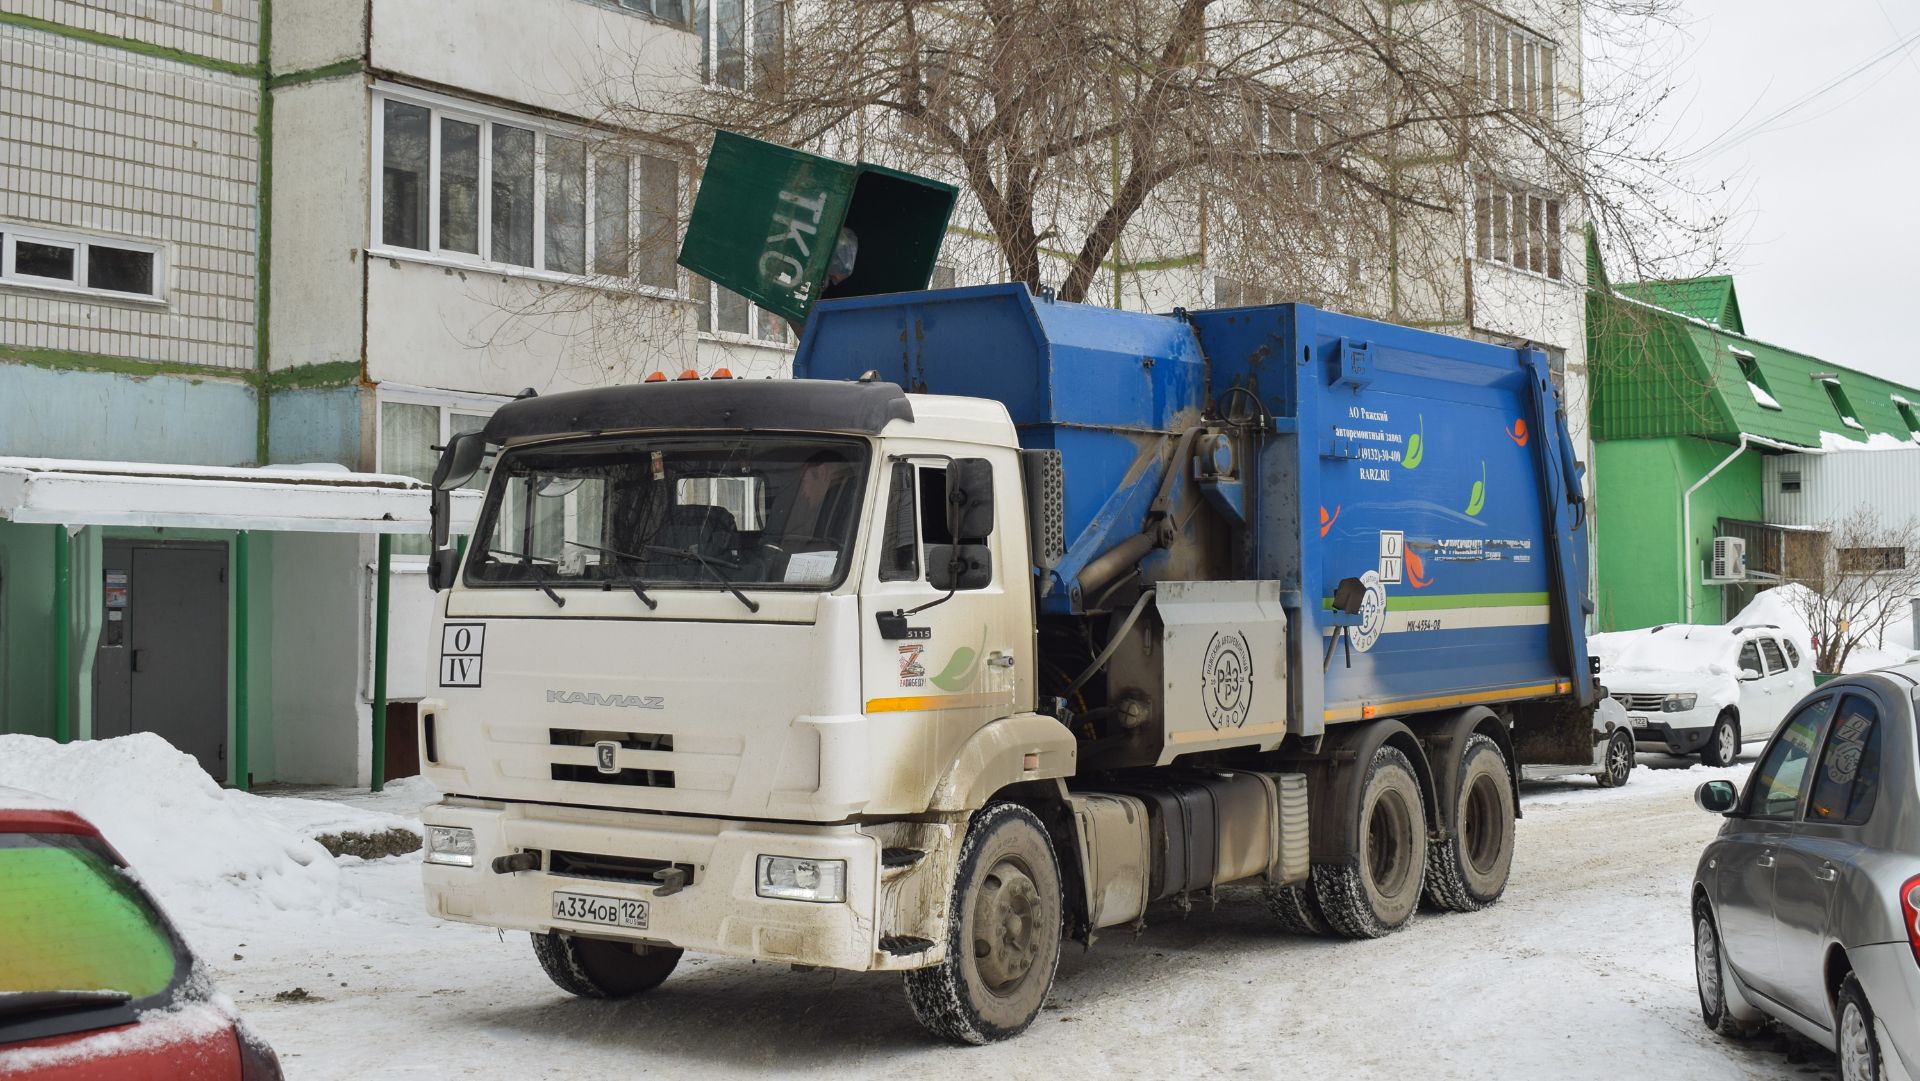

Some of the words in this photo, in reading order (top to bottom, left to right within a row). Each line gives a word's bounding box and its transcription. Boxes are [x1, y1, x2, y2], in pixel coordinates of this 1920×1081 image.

[1360, 468, 1389, 481] RARZ.RU
[1384, 560, 1398, 579] IV
[448, 658, 473, 682] IV
[546, 690, 665, 709] KAMAZ
[621, 902, 645, 920] 122
